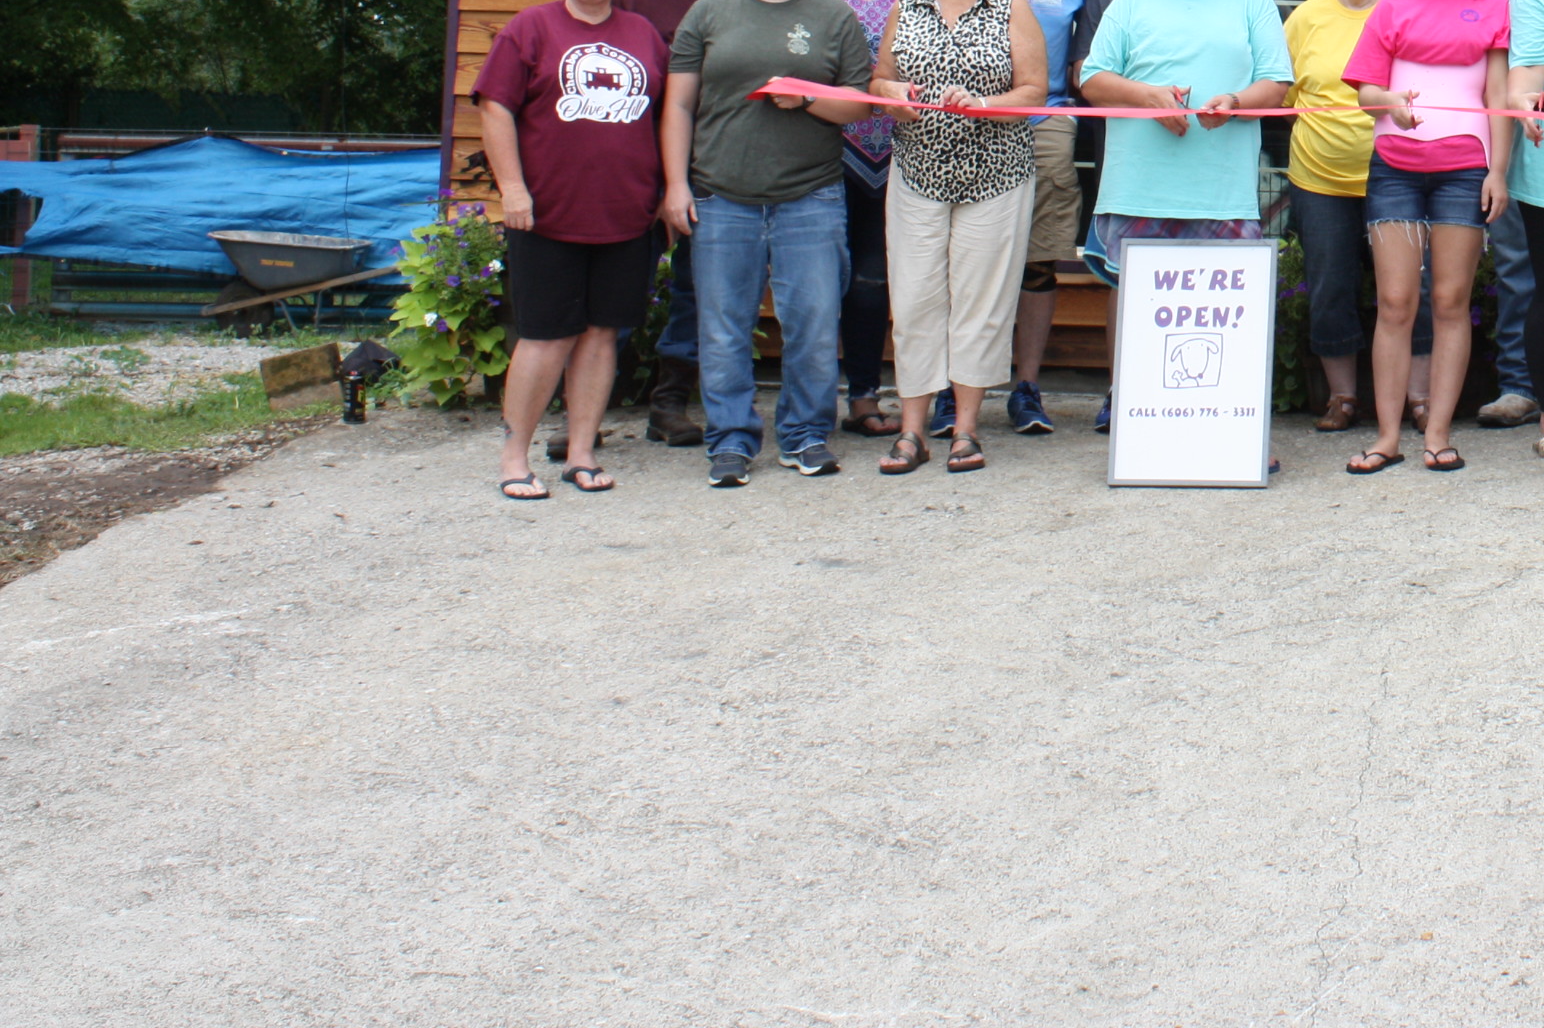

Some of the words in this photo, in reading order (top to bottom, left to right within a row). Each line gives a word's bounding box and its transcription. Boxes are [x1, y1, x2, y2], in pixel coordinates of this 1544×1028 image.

[564, 49, 583, 95] Chamber
[601, 46, 642, 95] Commerce
[559, 97, 606, 119] Olive
[609, 98, 646, 120] Hill
[1153, 268, 1246, 292] WE'RE
[1153, 305, 1245, 329] OPEN!
[1128, 407, 1157, 418] CALL
[1161, 407, 1195, 418] (606)
[1199, 407, 1220, 418] 776
[1232, 407, 1257, 418] 3311
